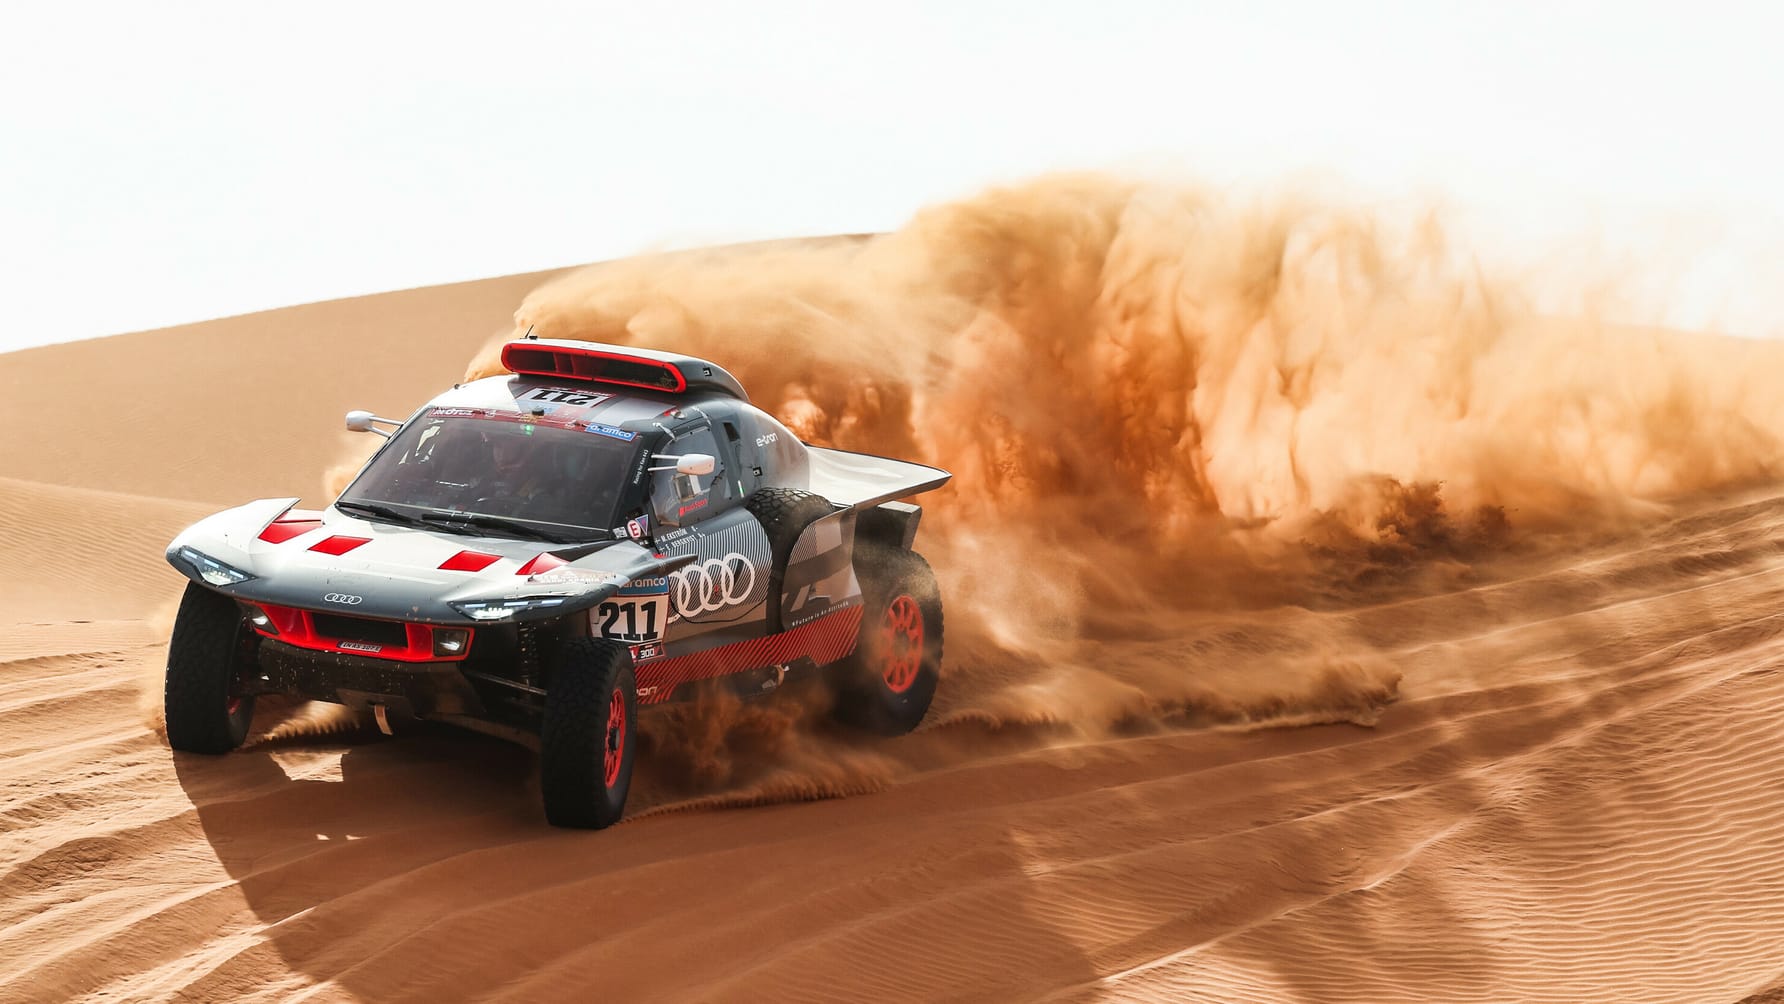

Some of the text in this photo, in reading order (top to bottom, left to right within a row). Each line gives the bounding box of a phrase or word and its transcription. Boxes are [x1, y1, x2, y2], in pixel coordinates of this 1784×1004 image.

[530, 390, 598, 405] 211
[599, 601, 658, 641] 211
[640, 648, 654, 658] 300
